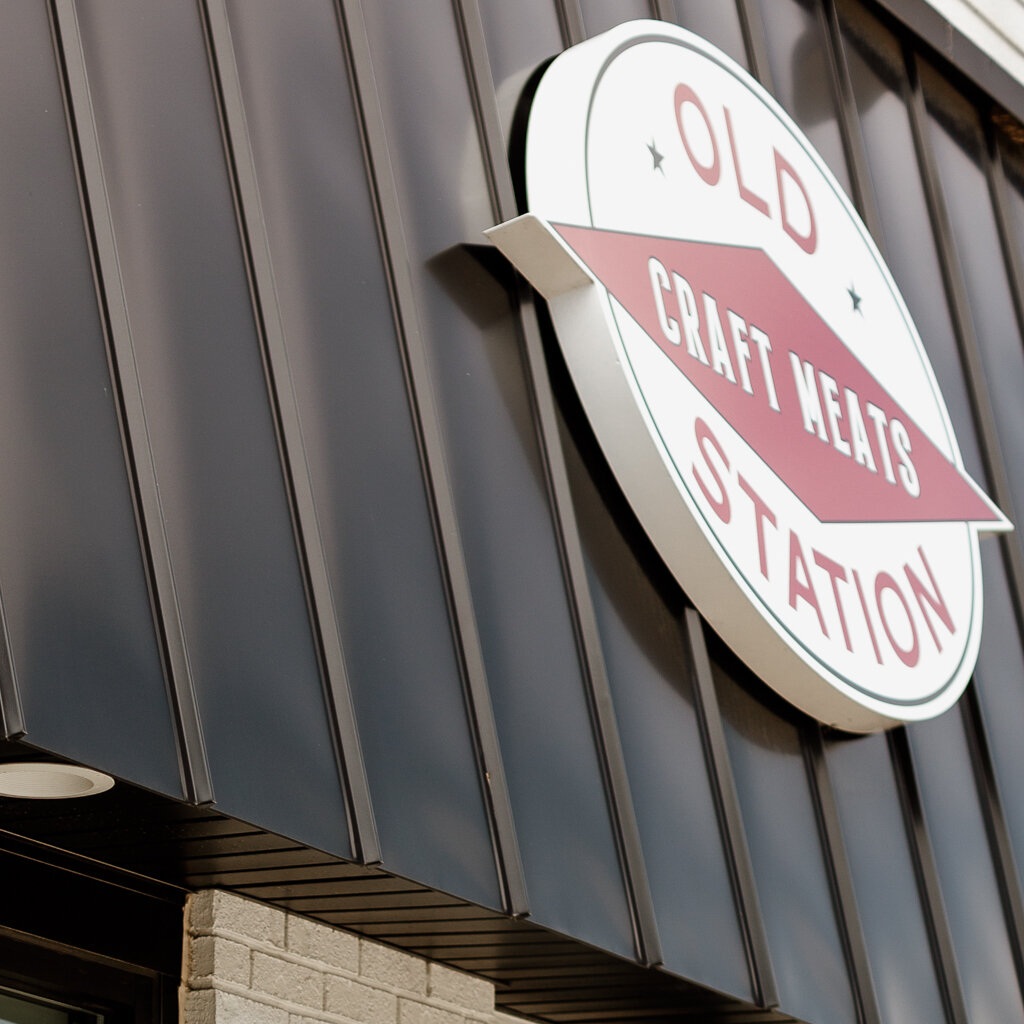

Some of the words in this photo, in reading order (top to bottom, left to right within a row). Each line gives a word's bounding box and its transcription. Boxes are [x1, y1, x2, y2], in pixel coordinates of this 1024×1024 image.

[674, 83, 817, 254] OLD
[648, 256, 782, 414] CRAFT
[788, 350, 921, 499] MEATS
[692, 417, 956, 668] STATION
